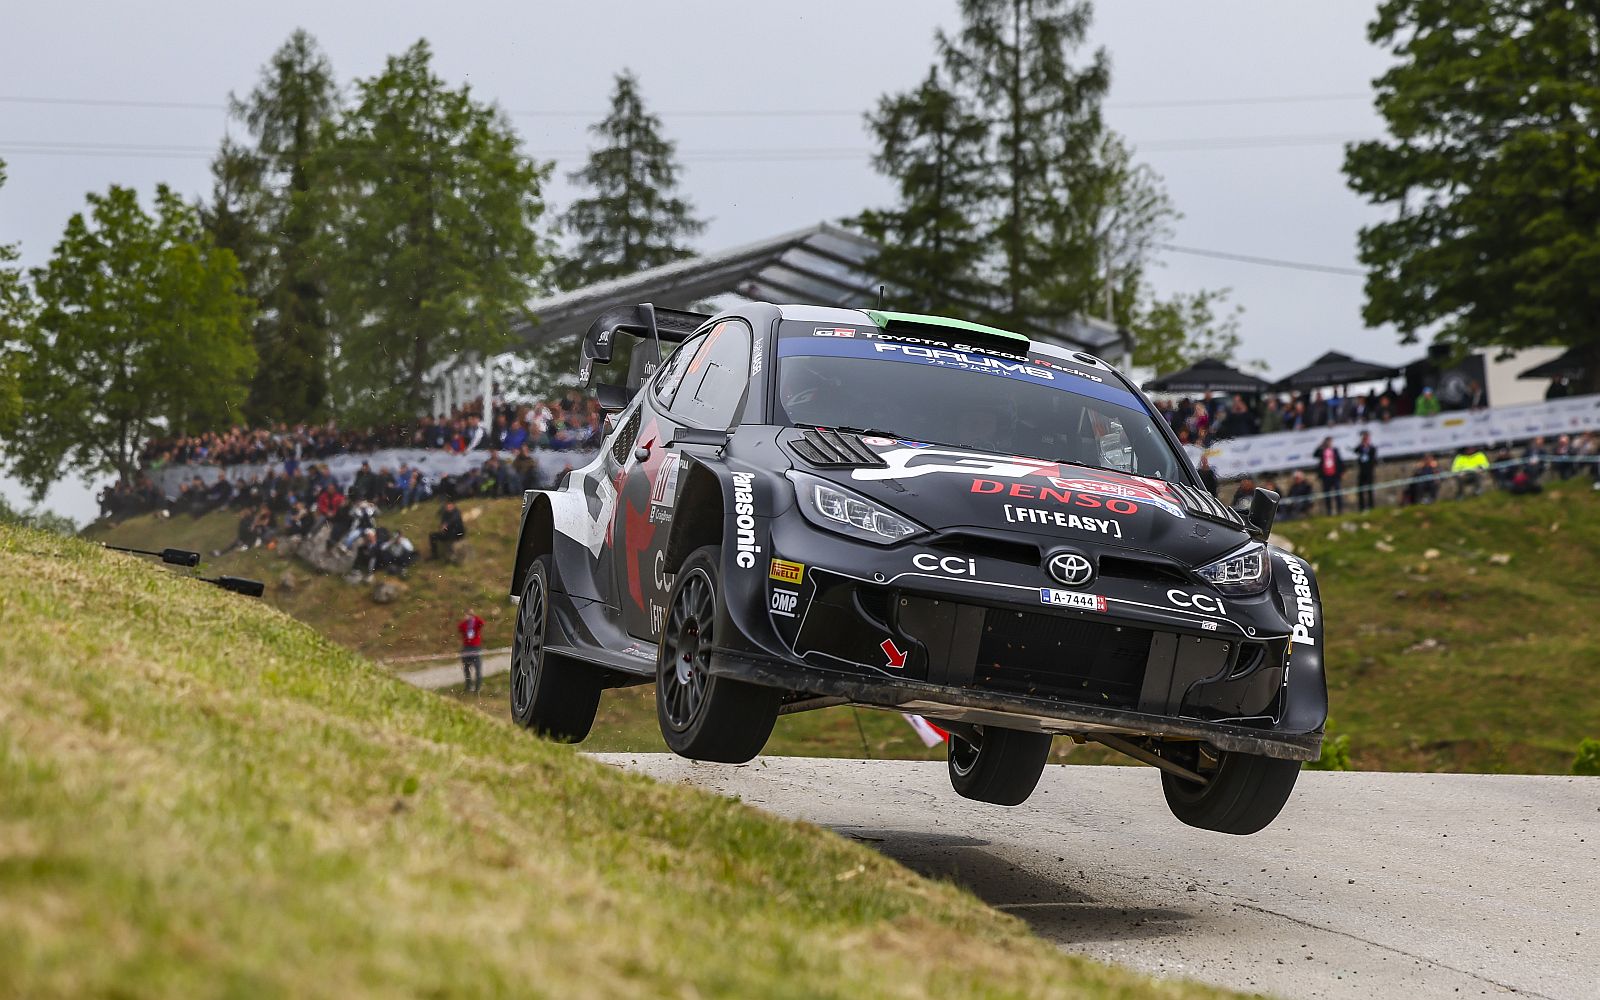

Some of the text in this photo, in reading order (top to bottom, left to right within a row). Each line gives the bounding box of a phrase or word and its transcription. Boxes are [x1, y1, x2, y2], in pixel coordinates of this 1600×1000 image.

[861, 332, 948, 347] TOYOTA
[1033, 359, 1103, 383] Racing
[873, 342, 1055, 380] FORUM8
[925, 357, 1012, 376] フォーラムエイト
[970, 479, 1138, 515] DENSO
[731, 471, 762, 569] Panasonic
[770, 562, 801, 580] PIRELLI
[771, 592, 798, 613] OMP
[1054, 592, 1094, 607] A-7444
